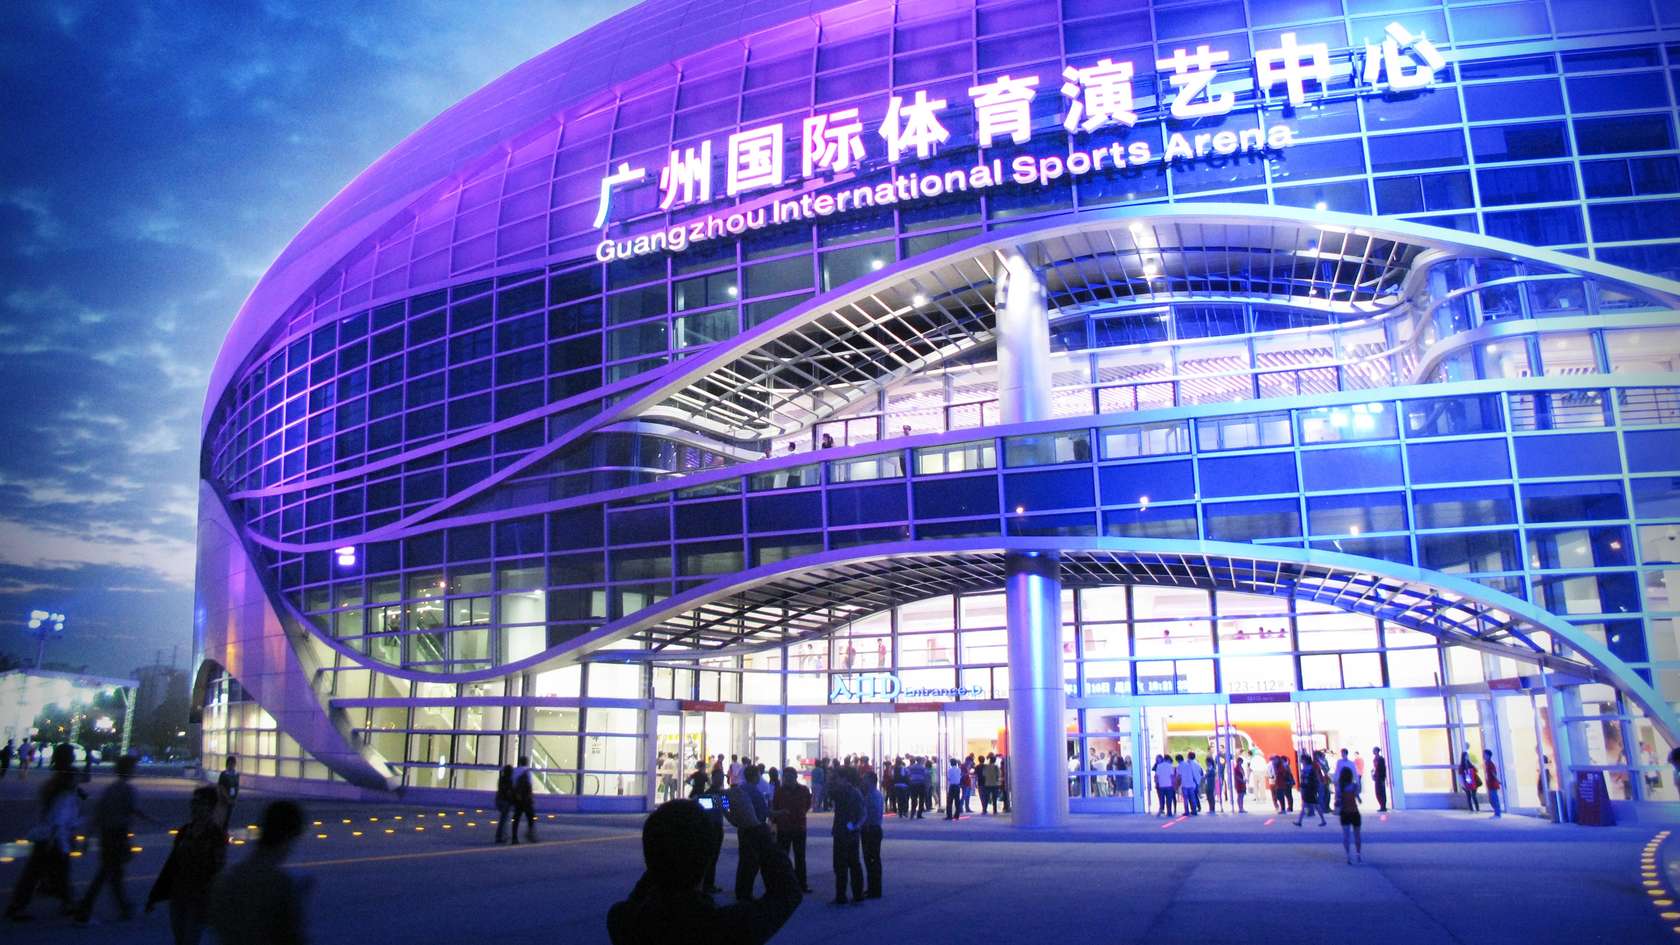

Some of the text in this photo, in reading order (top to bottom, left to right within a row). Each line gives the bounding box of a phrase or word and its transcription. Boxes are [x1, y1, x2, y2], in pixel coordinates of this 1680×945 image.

[593, 22, 1447, 229] 广州国际体育演艺中心
[595, 122, 1294, 263] Guangzhou International Sports Arena
